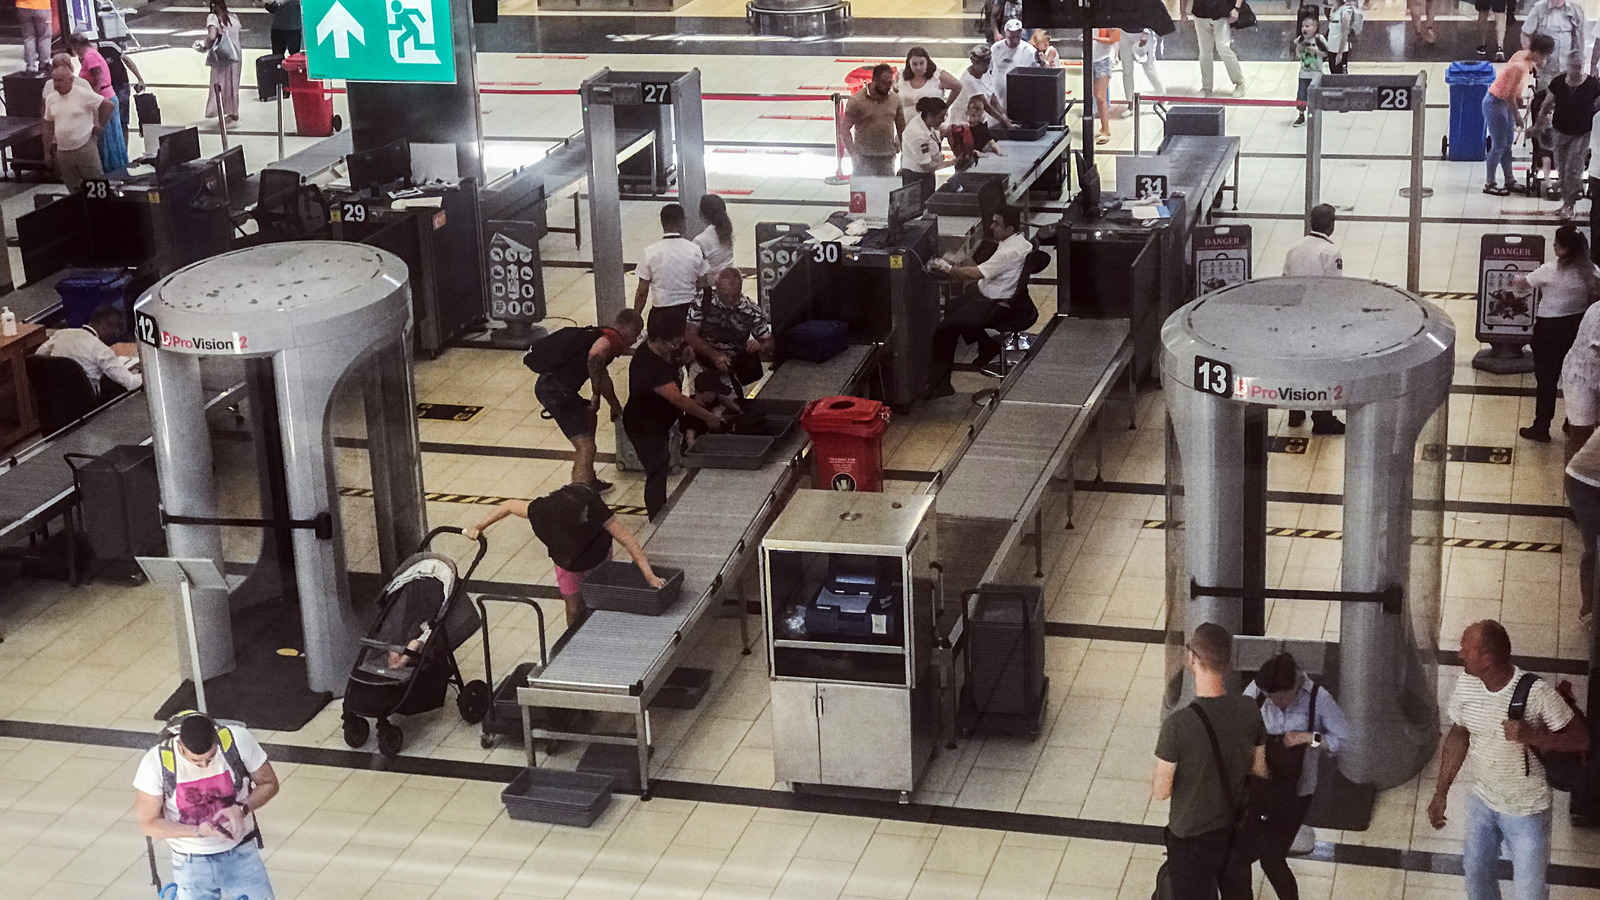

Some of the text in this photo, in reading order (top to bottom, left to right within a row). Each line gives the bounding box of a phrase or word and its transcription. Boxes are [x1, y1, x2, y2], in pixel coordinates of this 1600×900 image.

[644, 84, 668, 102] 27
[1380, 88, 1408, 108] 28
[86, 181, 107, 199] 28
[1140, 177, 1162, 197] 31
[343, 204, 365, 222] 29
[1204, 237, 1240, 246] DANGER
[813, 243, 838, 263] 30
[1493, 247, 1531, 256] DANGER
[139, 315, 156, 345] 12
[173, 335, 234, 350] ProVision
[239, 335, 248, 349] 2
[1198, 361, 1227, 394] 13
[1251, 385, 1327, 401] ProVision
[1333, 385, 1343, 400] 2
